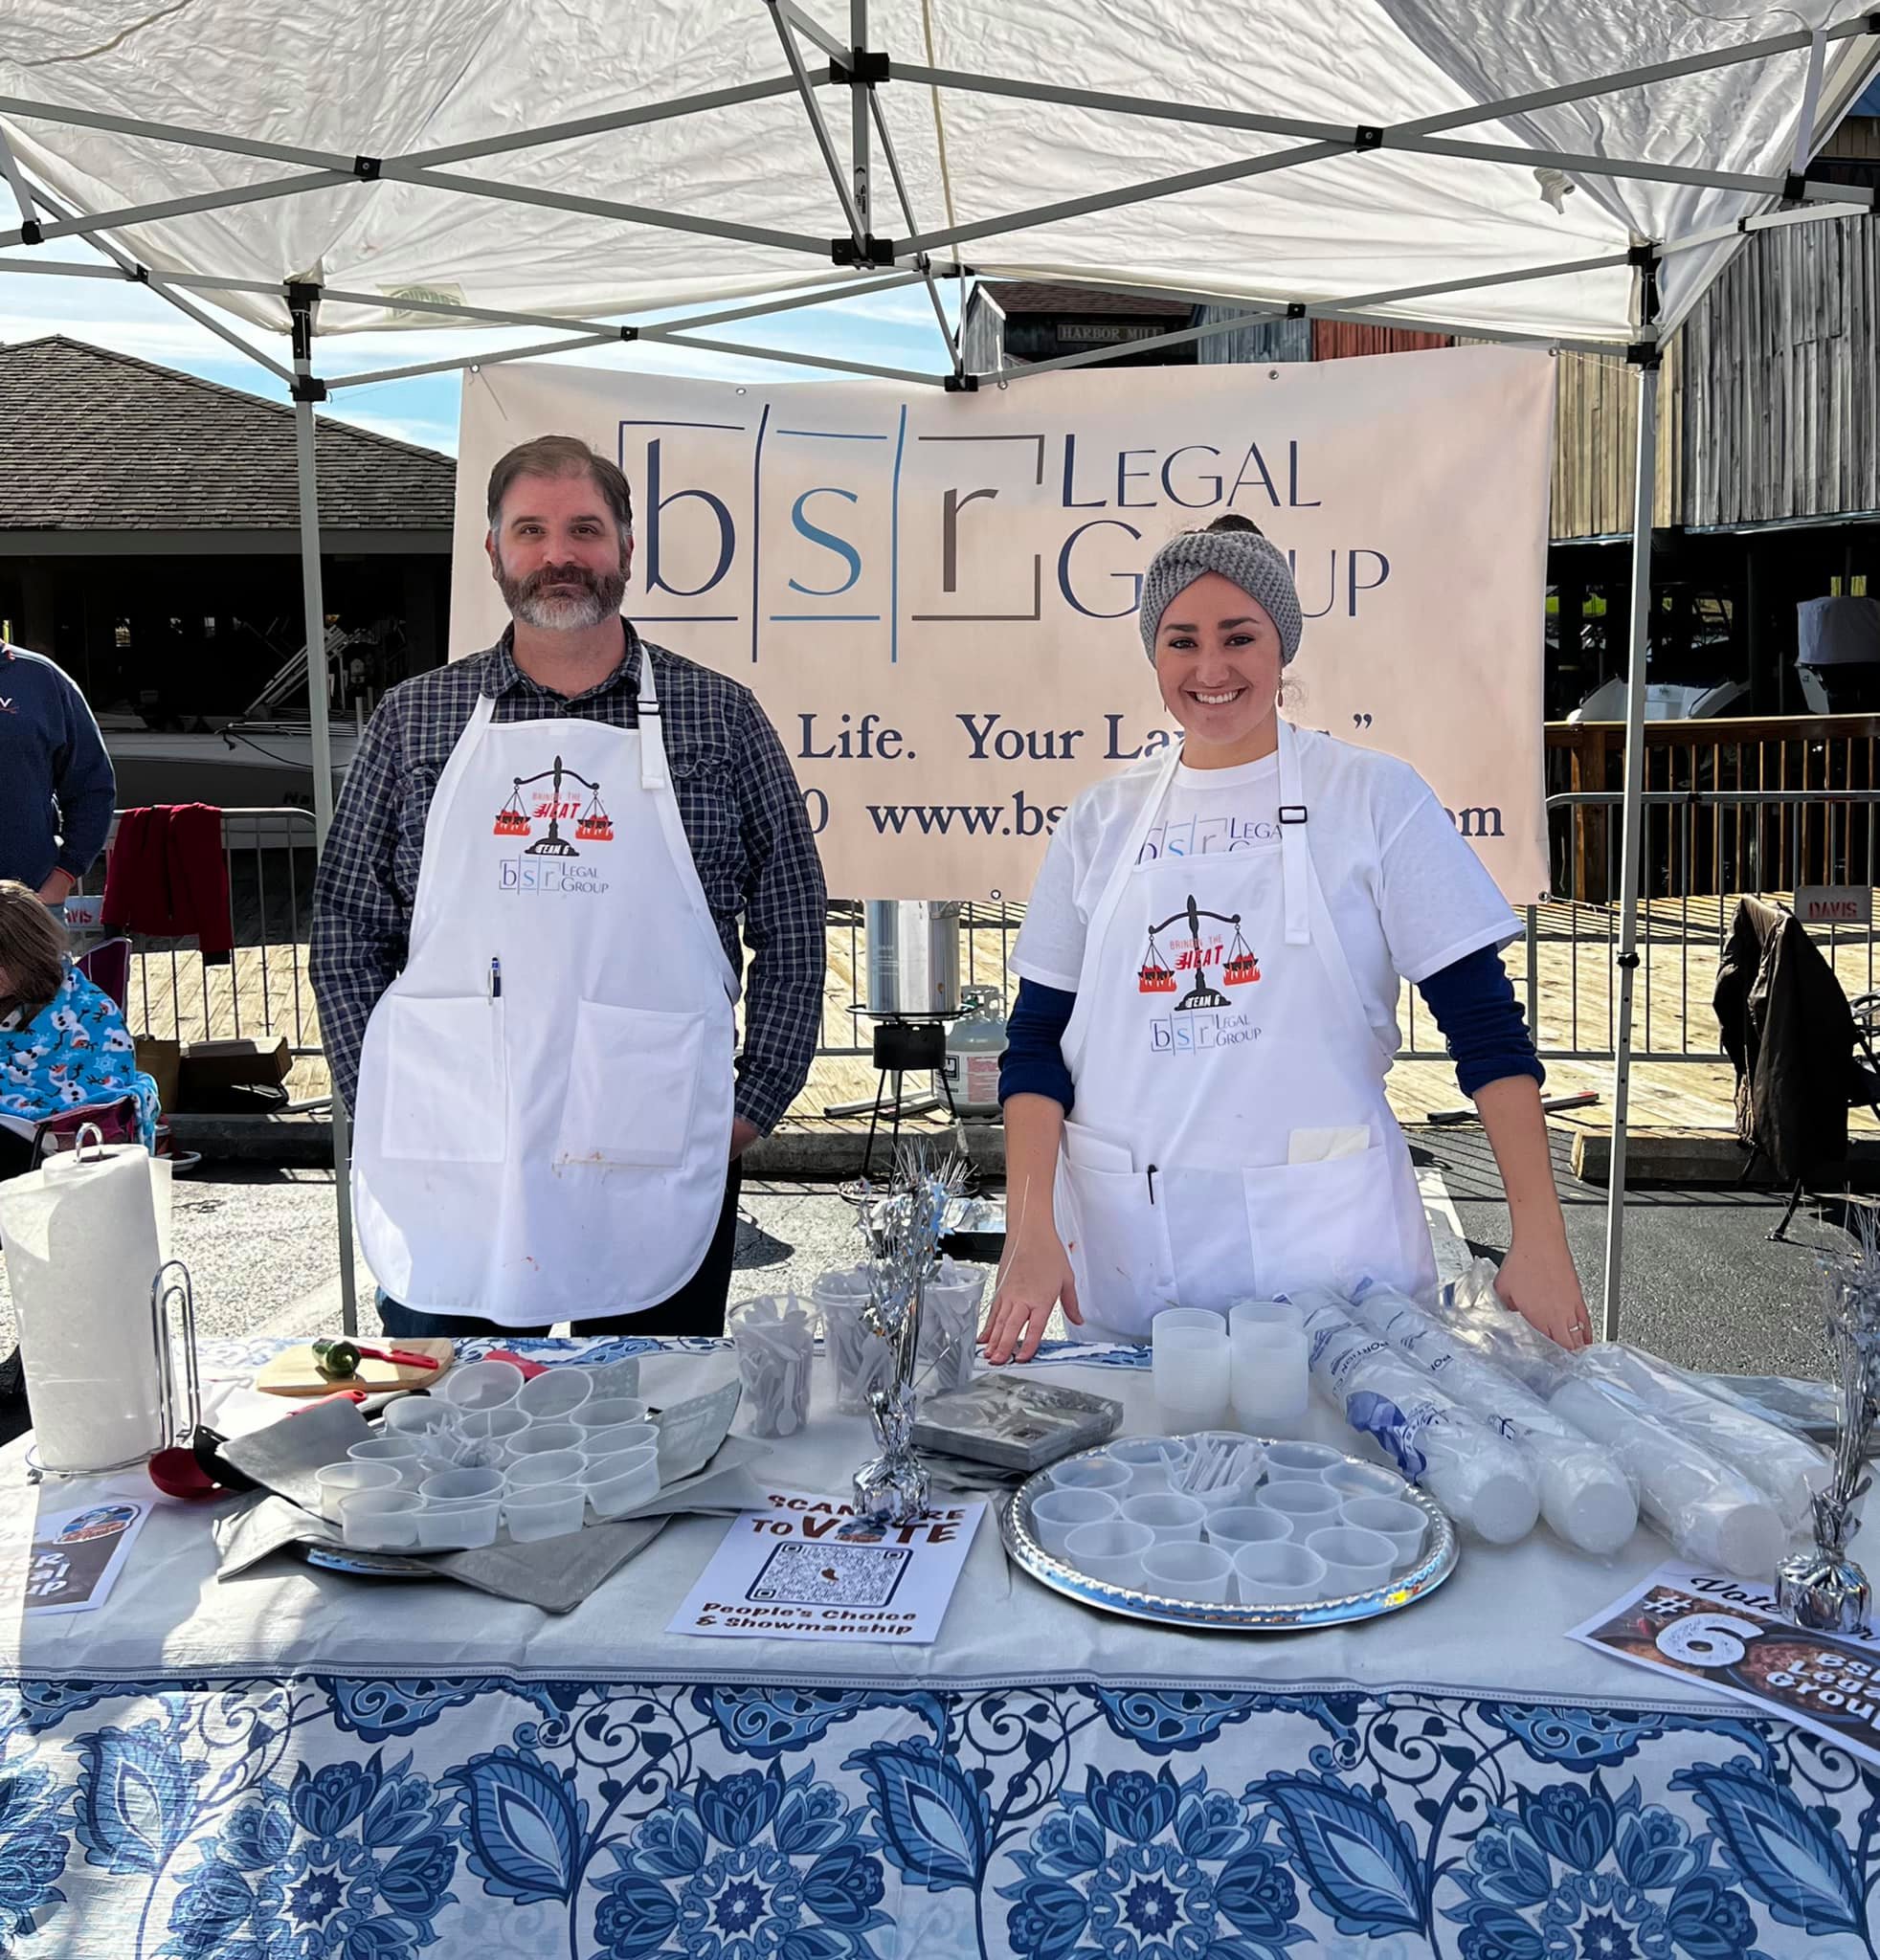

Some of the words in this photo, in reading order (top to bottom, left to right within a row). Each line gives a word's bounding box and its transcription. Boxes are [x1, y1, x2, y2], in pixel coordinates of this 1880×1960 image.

[1062, 326, 1120, 339] HARBOR
[1062, 434, 1322, 508] LEGAL
[1058, 520, 1391, 618] GUP
[796, 713, 917, 760] Life.
[955, 714, 1085, 760] Your
[532, 803, 581, 819] HEAT
[1230, 817, 1283, 840] LEGA
[535, 844, 561, 855] TEAM
[562, 861, 598, 878] LEGAL
[561, 877, 610, 894] GROUP
[1809, 902, 1857, 919] DAVIS
[1208, 934, 1223, 946] THE
[1175, 945, 1223, 969] HEAT
[1185, 994, 1211, 1008] TEAM
[1216, 1013, 1251, 1030] LEGAL
[1216, 1027, 1263, 1046] GROUP
[768, 1495, 855, 1517] SCAN
[751, 1519, 794, 1536] TO
[702, 1602, 813, 1618] People's
[821, 1609, 917, 1621] Choice
[696, 1615, 718, 1626] &
[724, 1615, 913, 1636] Showmanship
